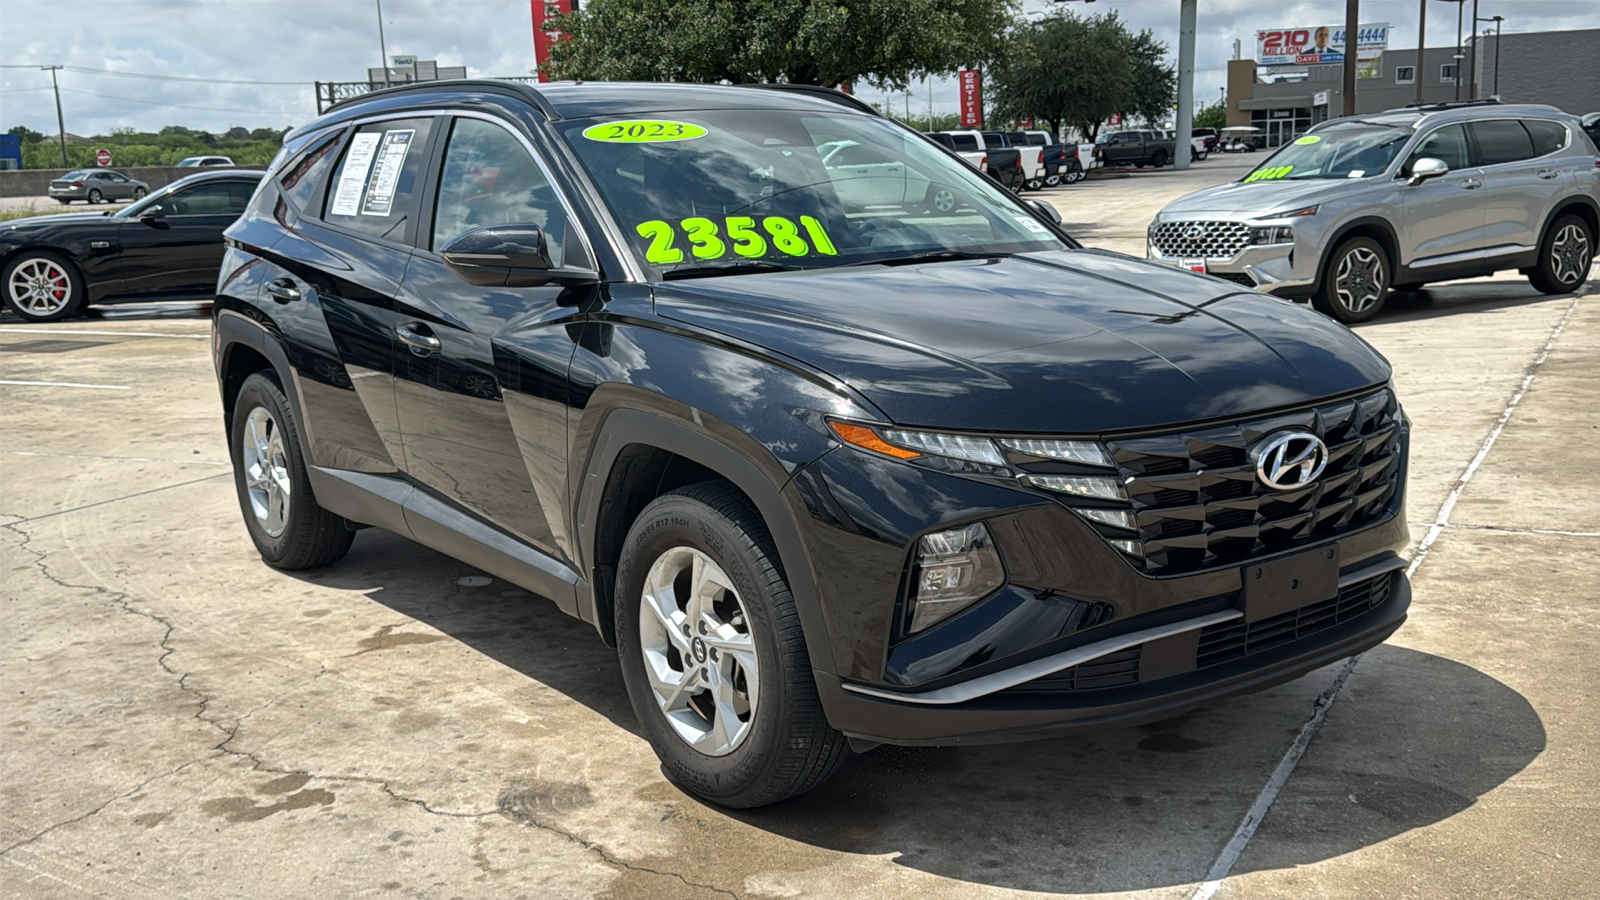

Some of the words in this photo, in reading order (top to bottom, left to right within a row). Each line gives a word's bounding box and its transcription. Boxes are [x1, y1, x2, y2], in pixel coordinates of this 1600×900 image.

[1258, 30, 1309, 48] $210
[1262, 47, 1302, 56] MILLION
[1296, 55, 1320, 63] DAVIS
[607, 124, 684, 139] 2023
[636, 215, 838, 263] 23581
[655, 518, 669, 528] R17
[670, 517, 690, 528] 104H
